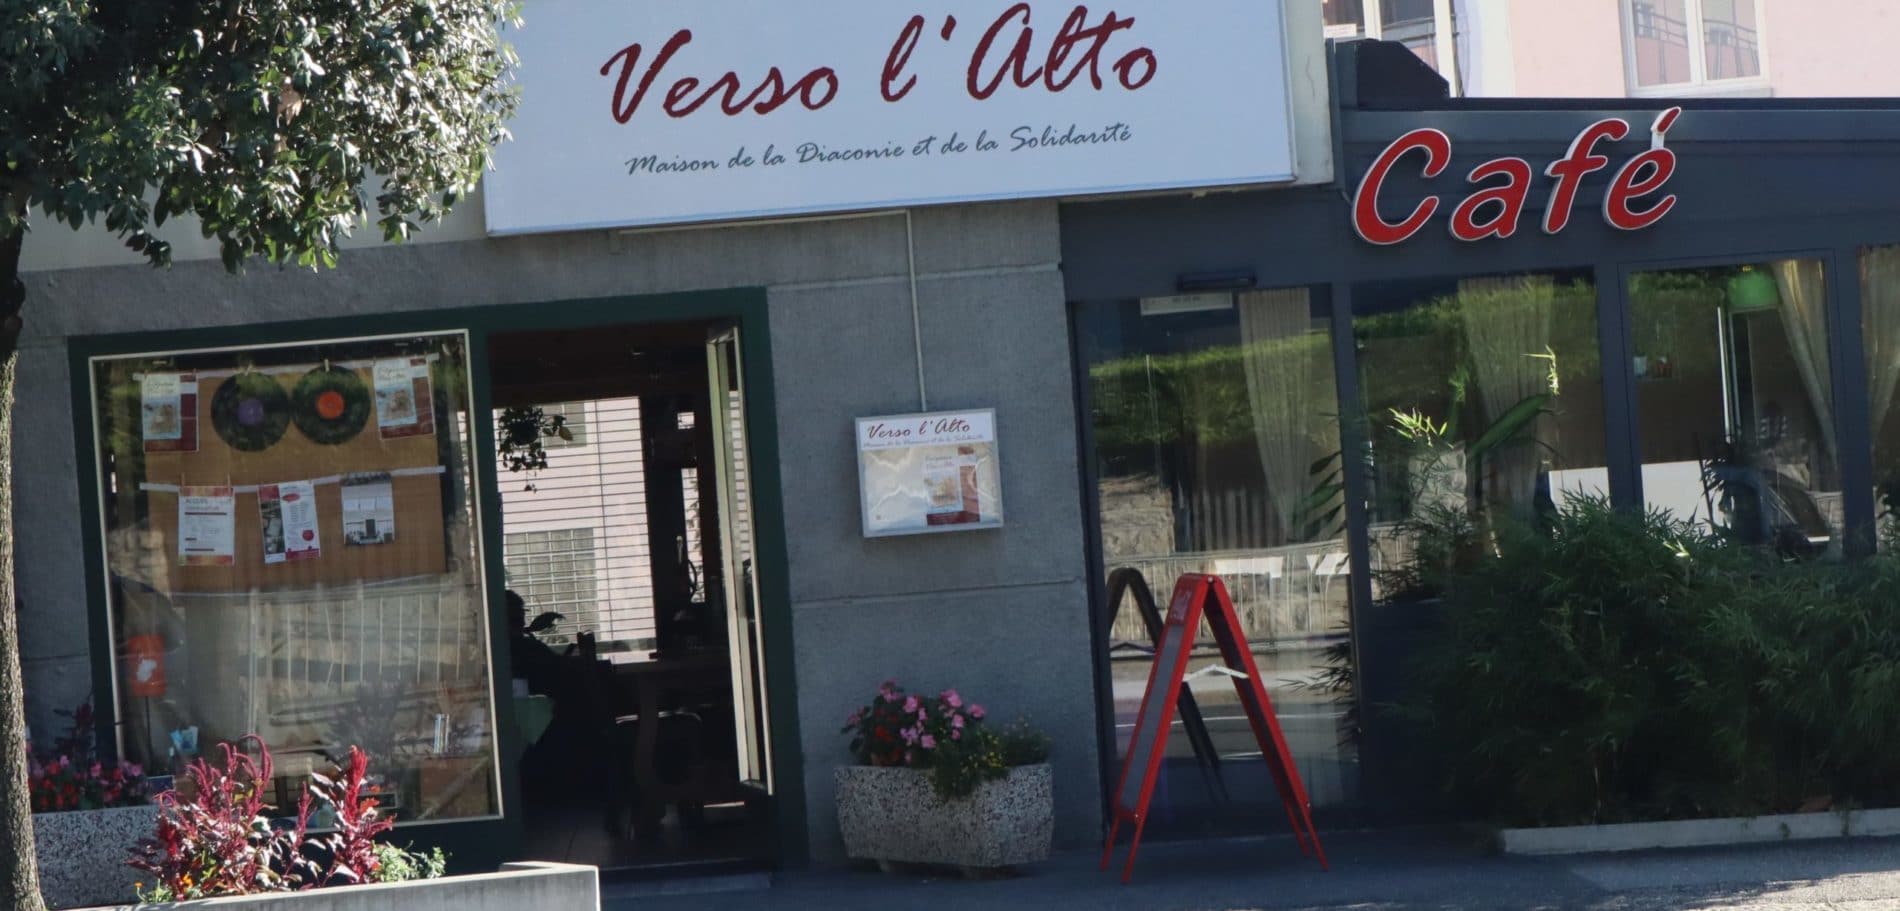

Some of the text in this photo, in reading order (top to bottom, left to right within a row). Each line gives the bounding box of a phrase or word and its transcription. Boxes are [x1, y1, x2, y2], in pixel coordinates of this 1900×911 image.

[600, 29, 838, 124] Verso
[624, 121, 1133, 177] Maison de la Diaconie et de la Solidarité
[1352, 106, 1681, 244] Café
[868, 423, 911, 438] Verso
